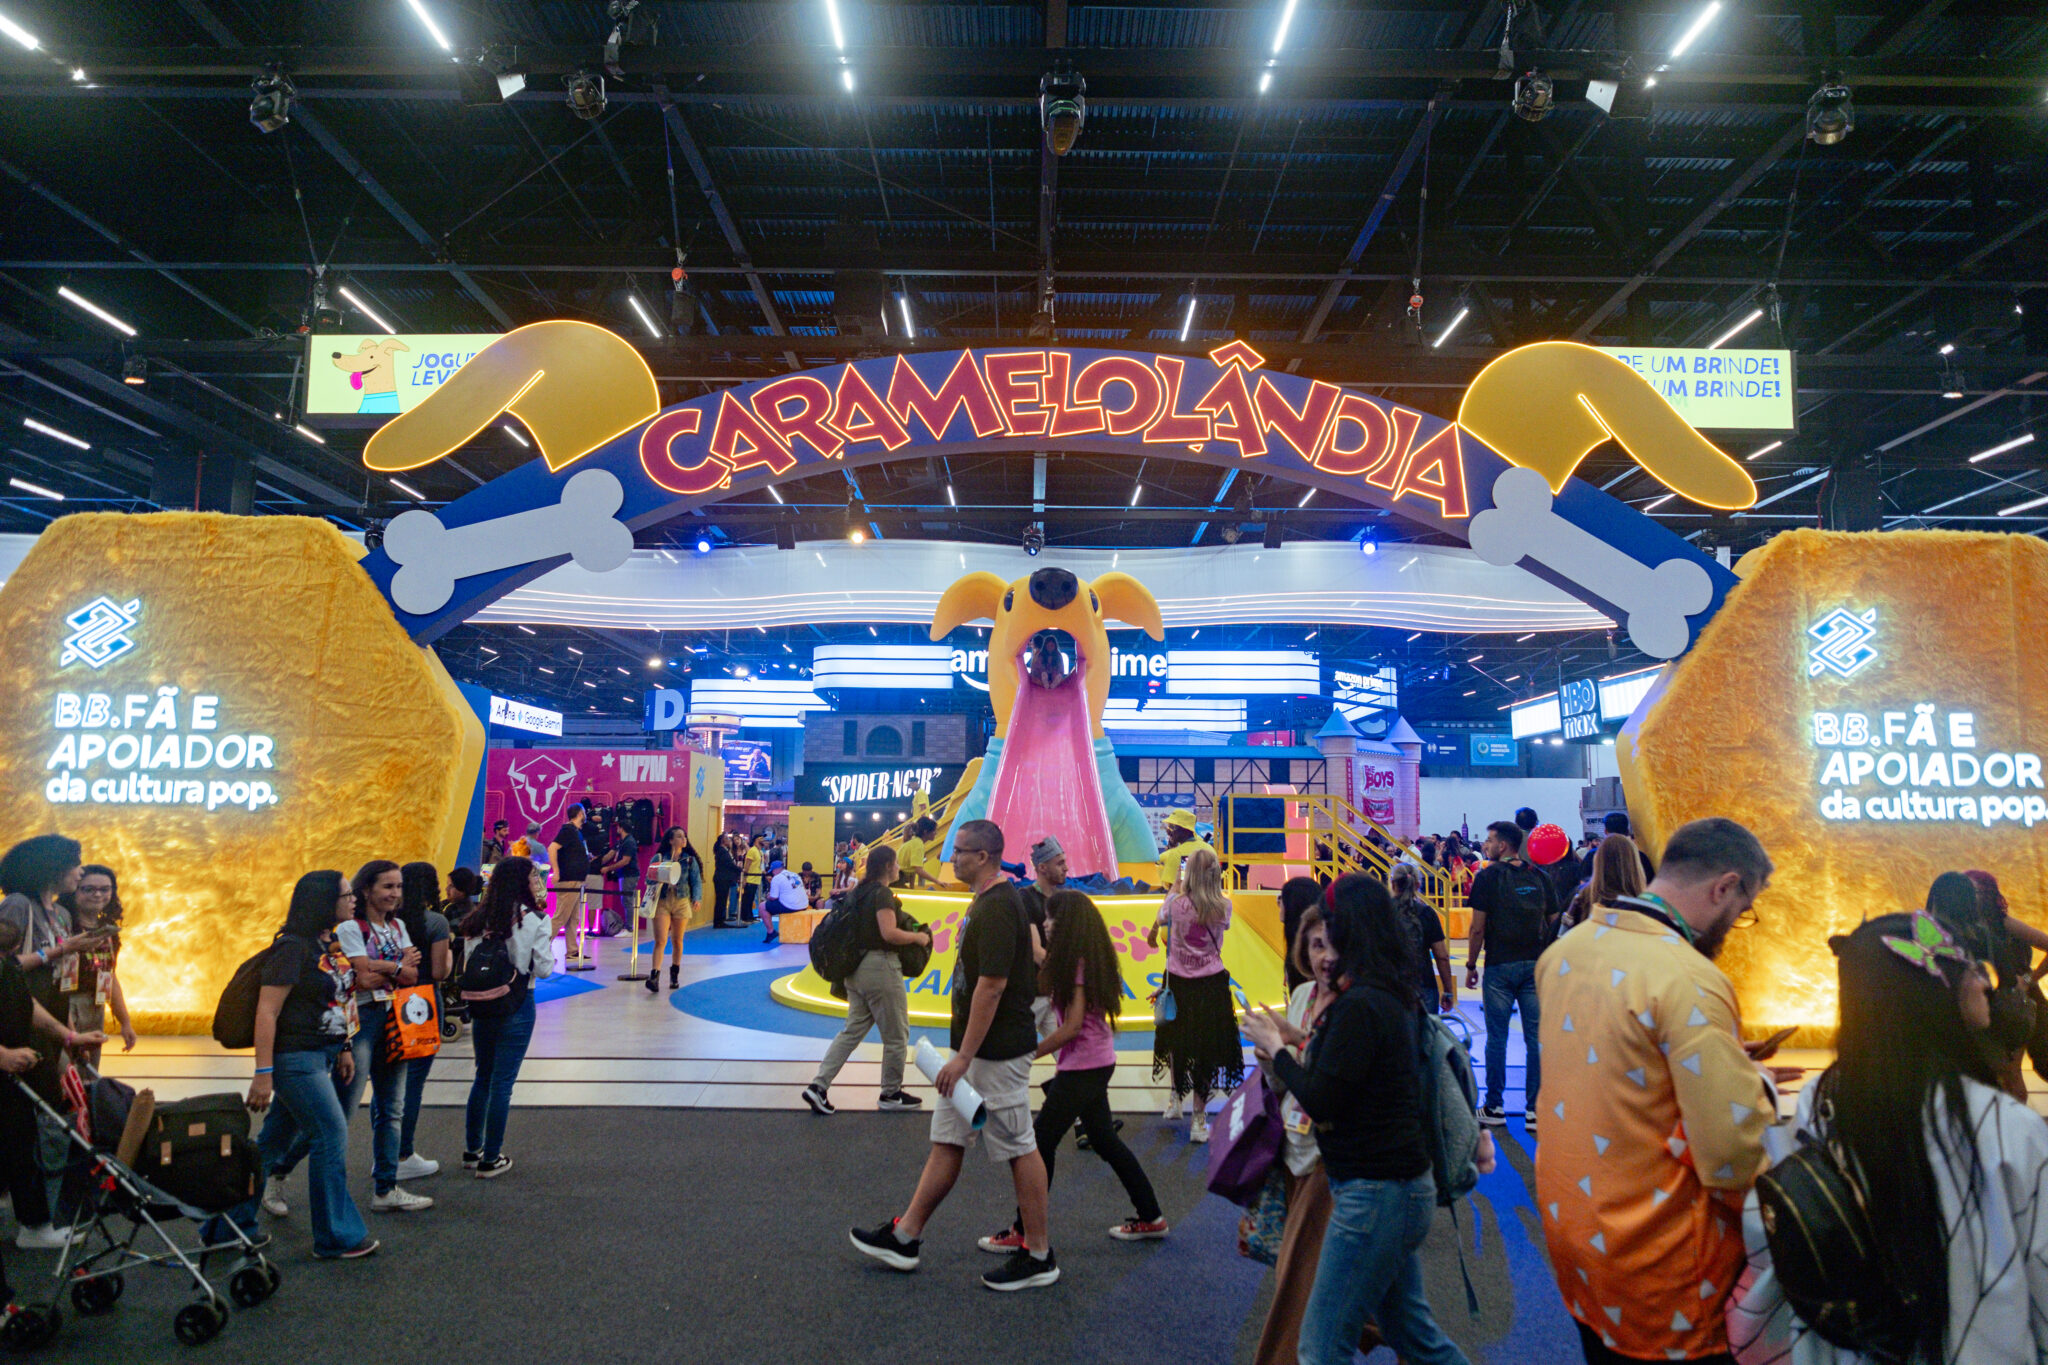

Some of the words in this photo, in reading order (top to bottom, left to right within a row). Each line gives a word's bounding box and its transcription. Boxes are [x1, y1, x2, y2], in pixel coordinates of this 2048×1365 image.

[412, 352, 477, 369] JOGU
[1652, 355, 1686, 373] UM
[1694, 356, 1780, 375] BRINDE!
[411, 369, 457, 386] LEV
[1695, 380, 1781, 398] BRINDE!
[639, 340, 1470, 518] CARAMELOLÂNDIA
[191, 696, 219, 729] E
[653, 689, 685, 730] D
[1560, 679, 1596, 716] HBO
[525, 711, 543, 729] Google
[1563, 712, 1599, 739] max
[1949, 712, 1976, 747] E
[46, 734, 274, 769] APOIADOR
[619, 755, 667, 782] W7M
[1364, 771, 1395, 790] BOYS
[1820, 752, 2044, 788] APOIADOR
[46, 771, 87, 803] da
[91, 772, 205, 803] cultura
[207, 780, 278, 811] pop.
[1820, 789, 1861, 820] da
[1865, 789, 1978, 821] cultura
